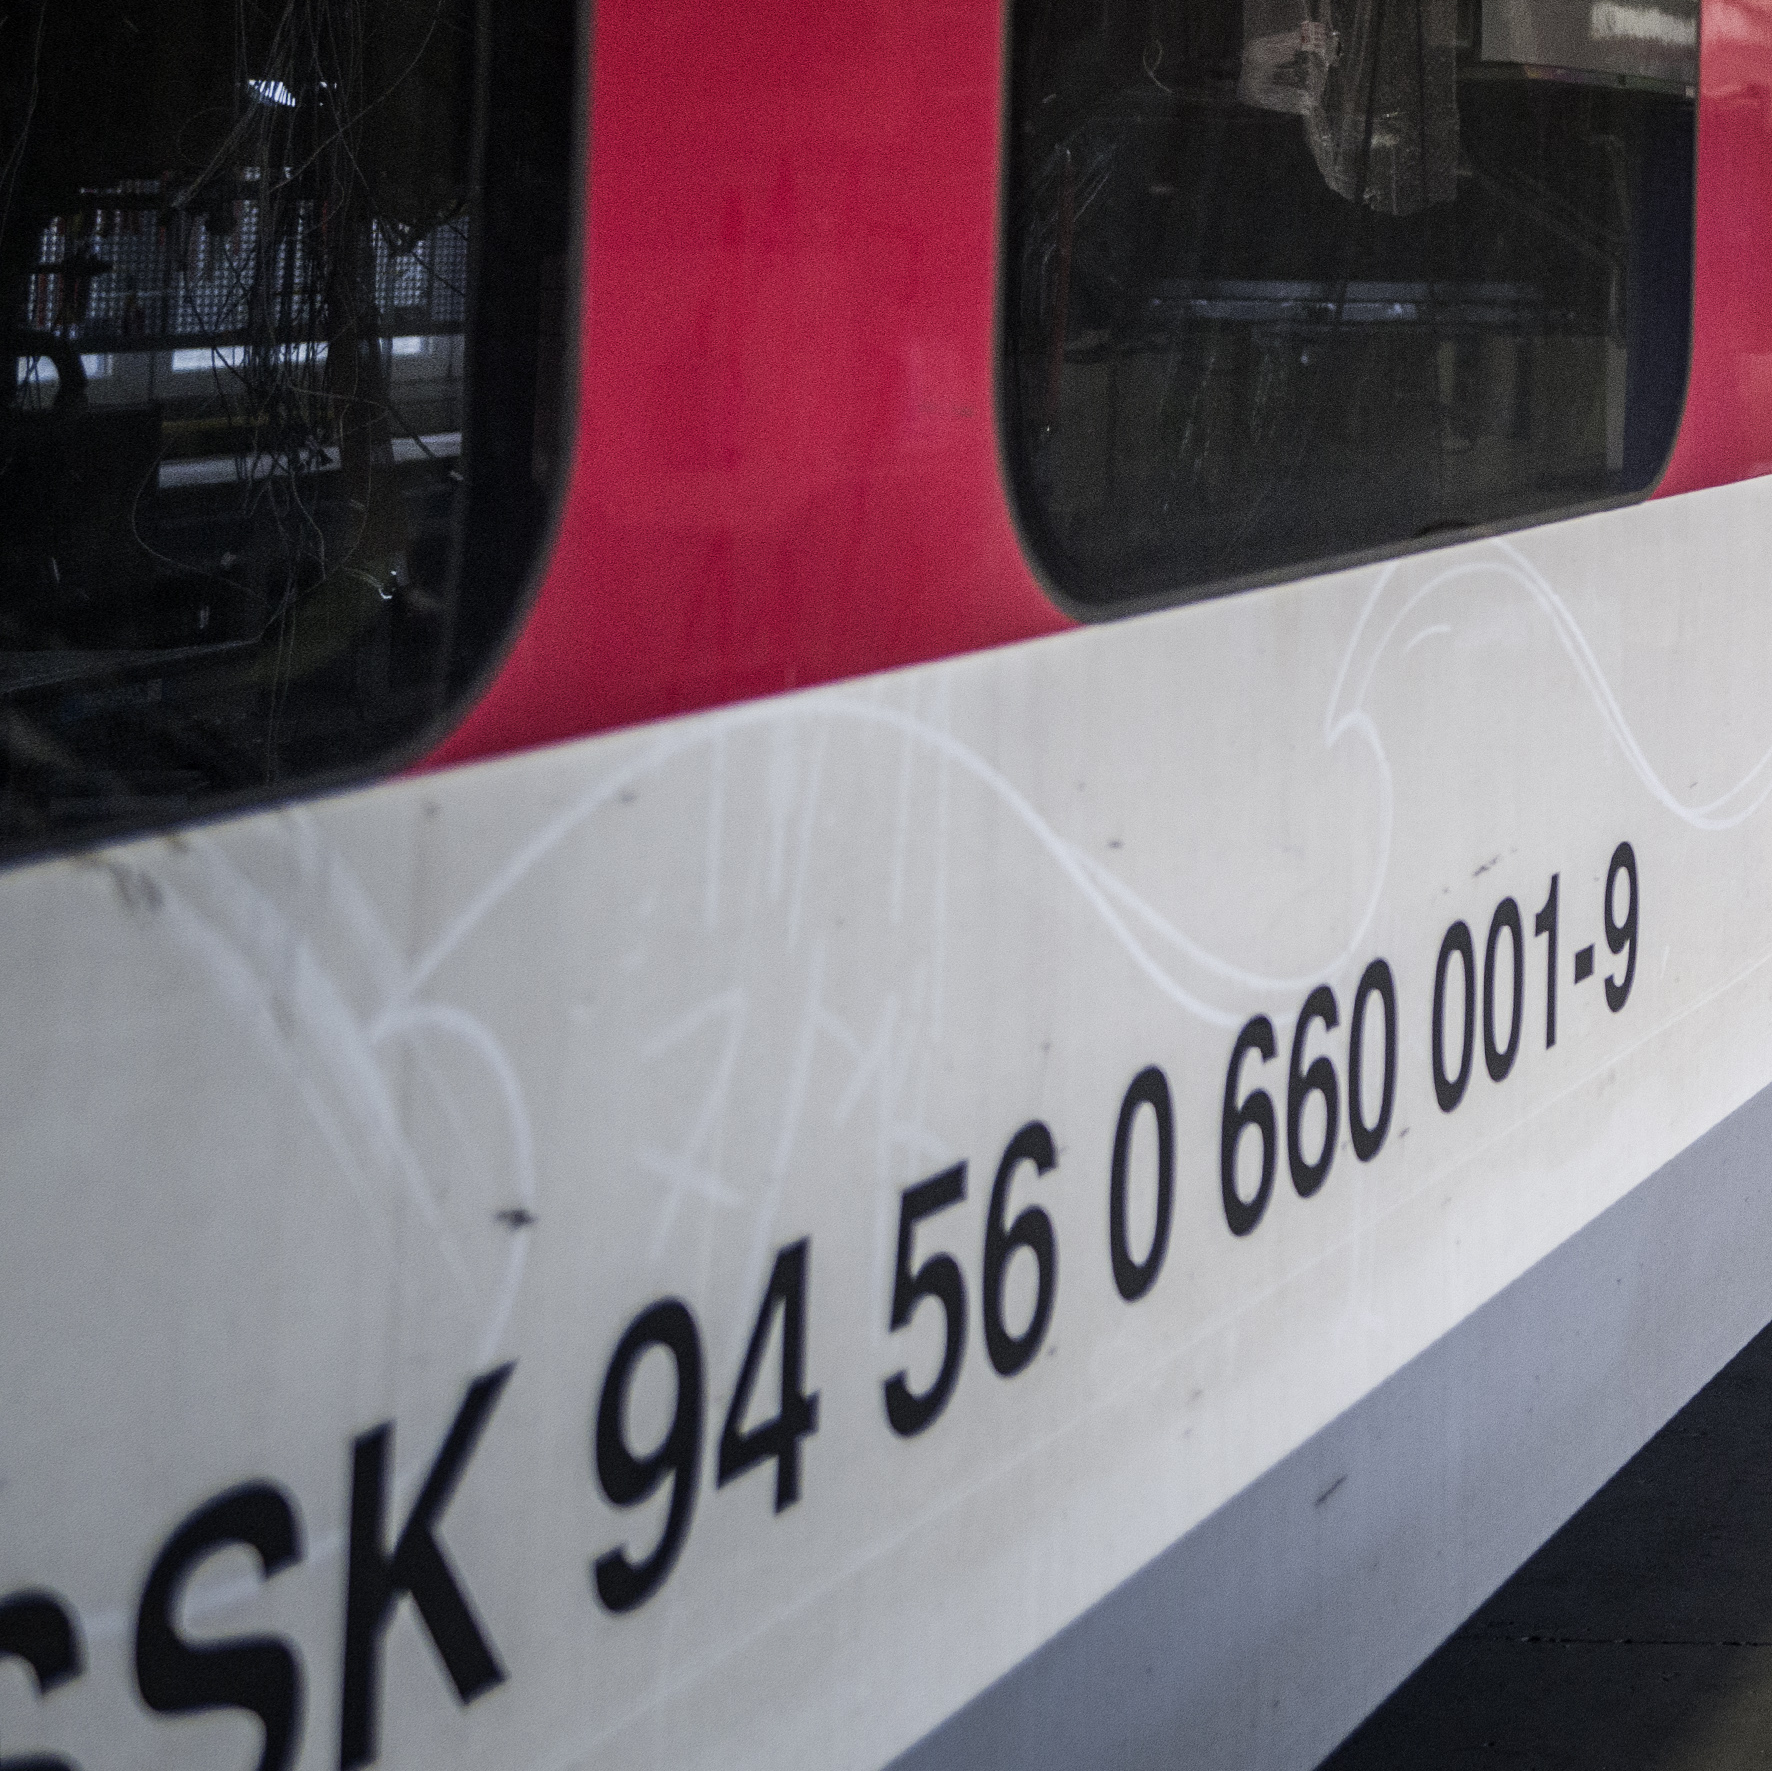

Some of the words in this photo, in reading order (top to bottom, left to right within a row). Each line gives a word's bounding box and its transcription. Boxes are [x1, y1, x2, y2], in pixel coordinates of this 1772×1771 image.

[590, 1236, 822, 1617] 94
[882, 1119, 1058, 1440] 56
[1108, 1065, 1176, 1303] 0
[1219, 958, 1398, 1238] 660
[1430, 840, 1640, 1114] 001-9
